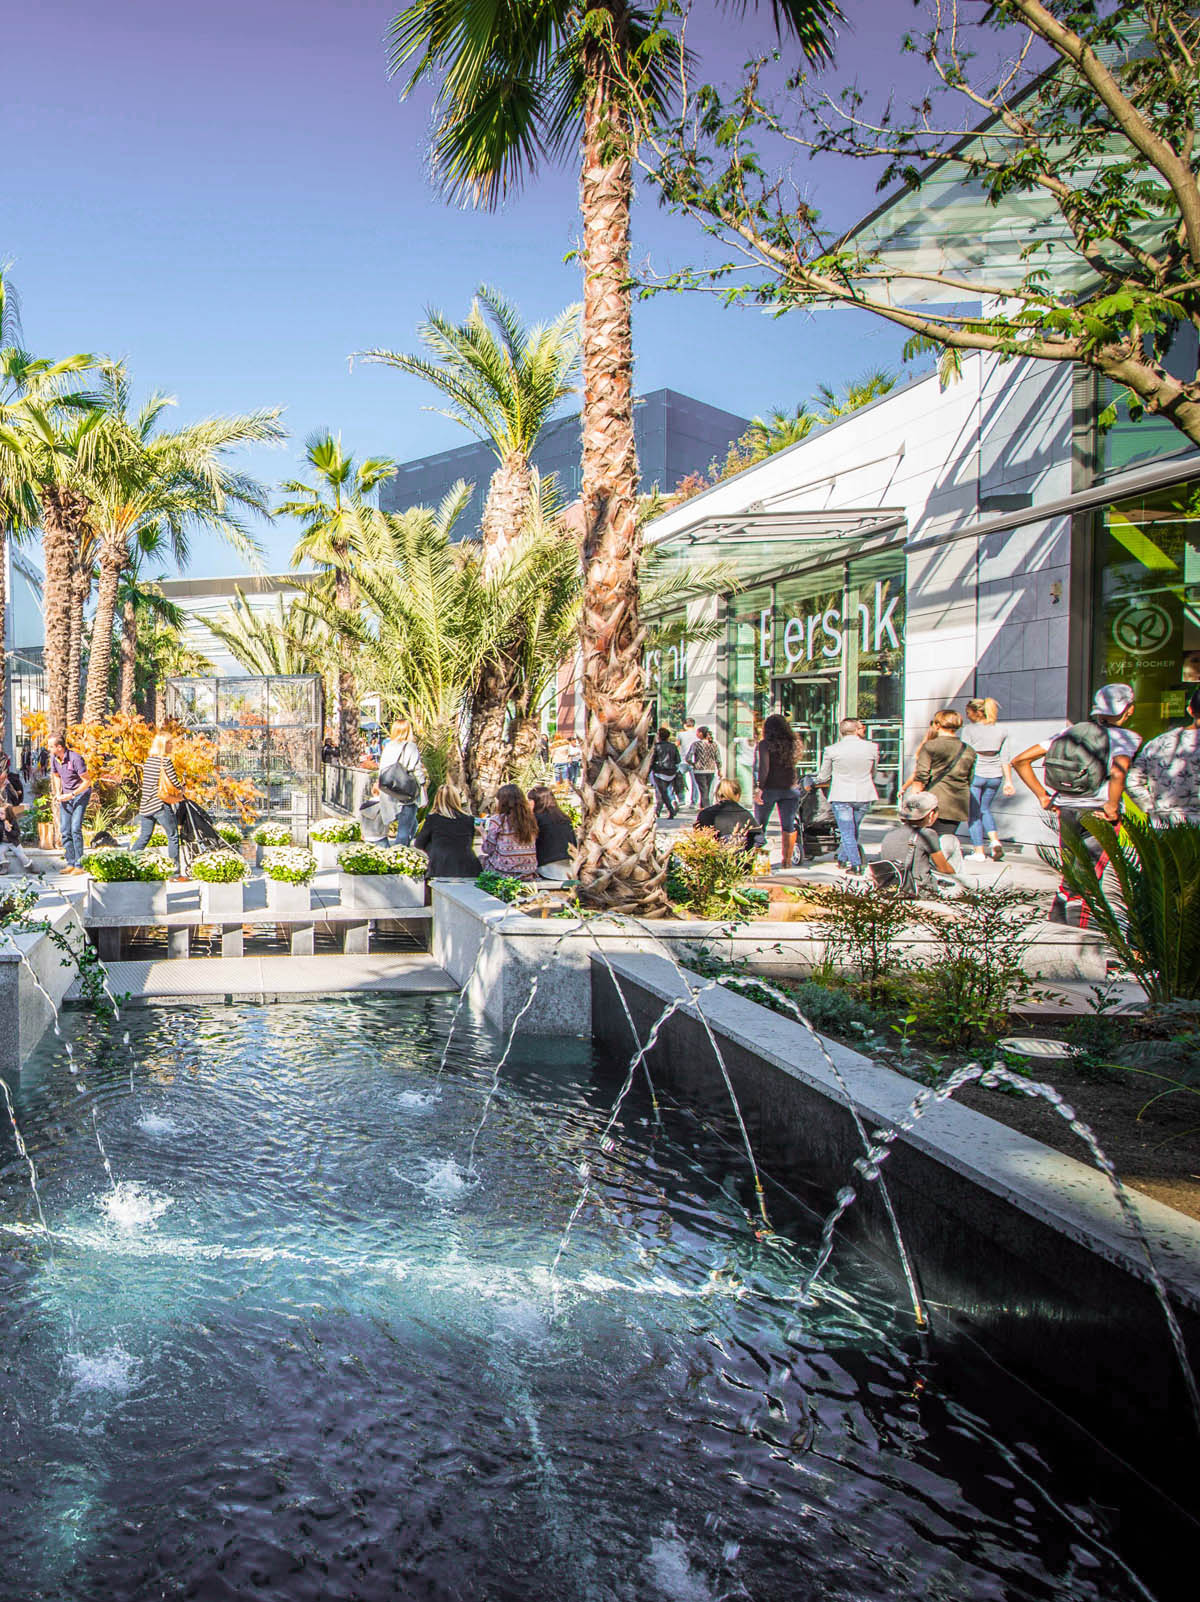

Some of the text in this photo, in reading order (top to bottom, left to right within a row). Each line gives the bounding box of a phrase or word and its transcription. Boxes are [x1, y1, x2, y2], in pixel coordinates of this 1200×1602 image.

[760, 581, 906, 667] ersk
[1110, 660, 1176, 668] YVES ROCHER
